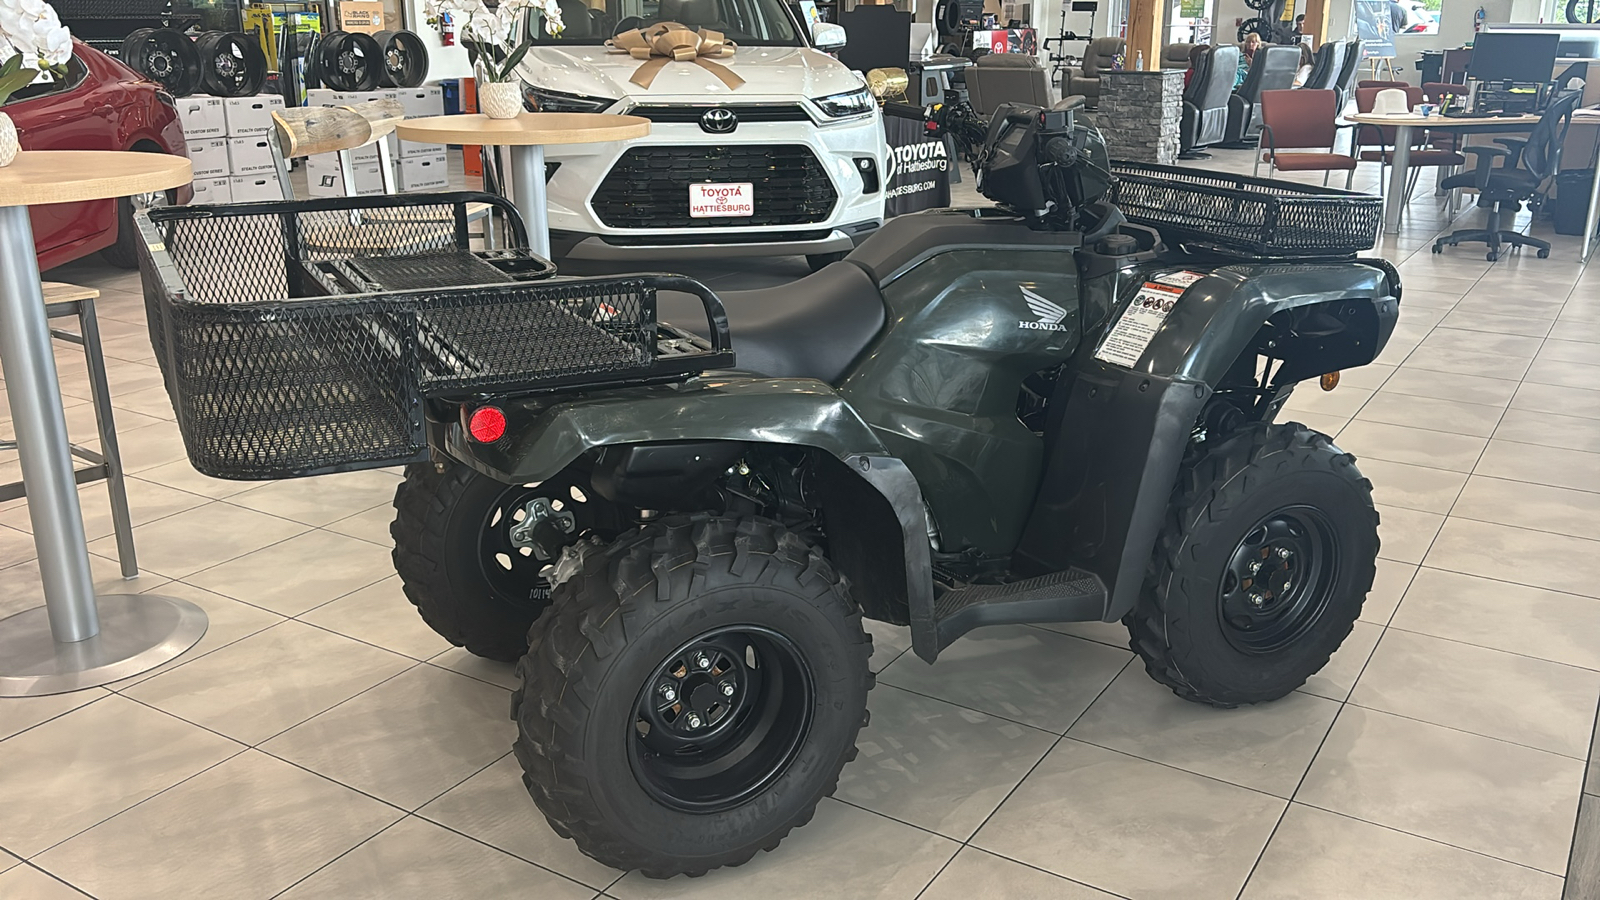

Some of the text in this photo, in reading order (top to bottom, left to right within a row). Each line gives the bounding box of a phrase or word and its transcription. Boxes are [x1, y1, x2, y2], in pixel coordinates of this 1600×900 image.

[895, 141, 947, 163] TOYOTA
[897, 159, 947, 175] of Hattiesburg
[701, 188, 742, 197] TOYOTA
[693, 204, 750, 212] HATTIESBURG
[1018, 321, 1067, 332] HONDA
